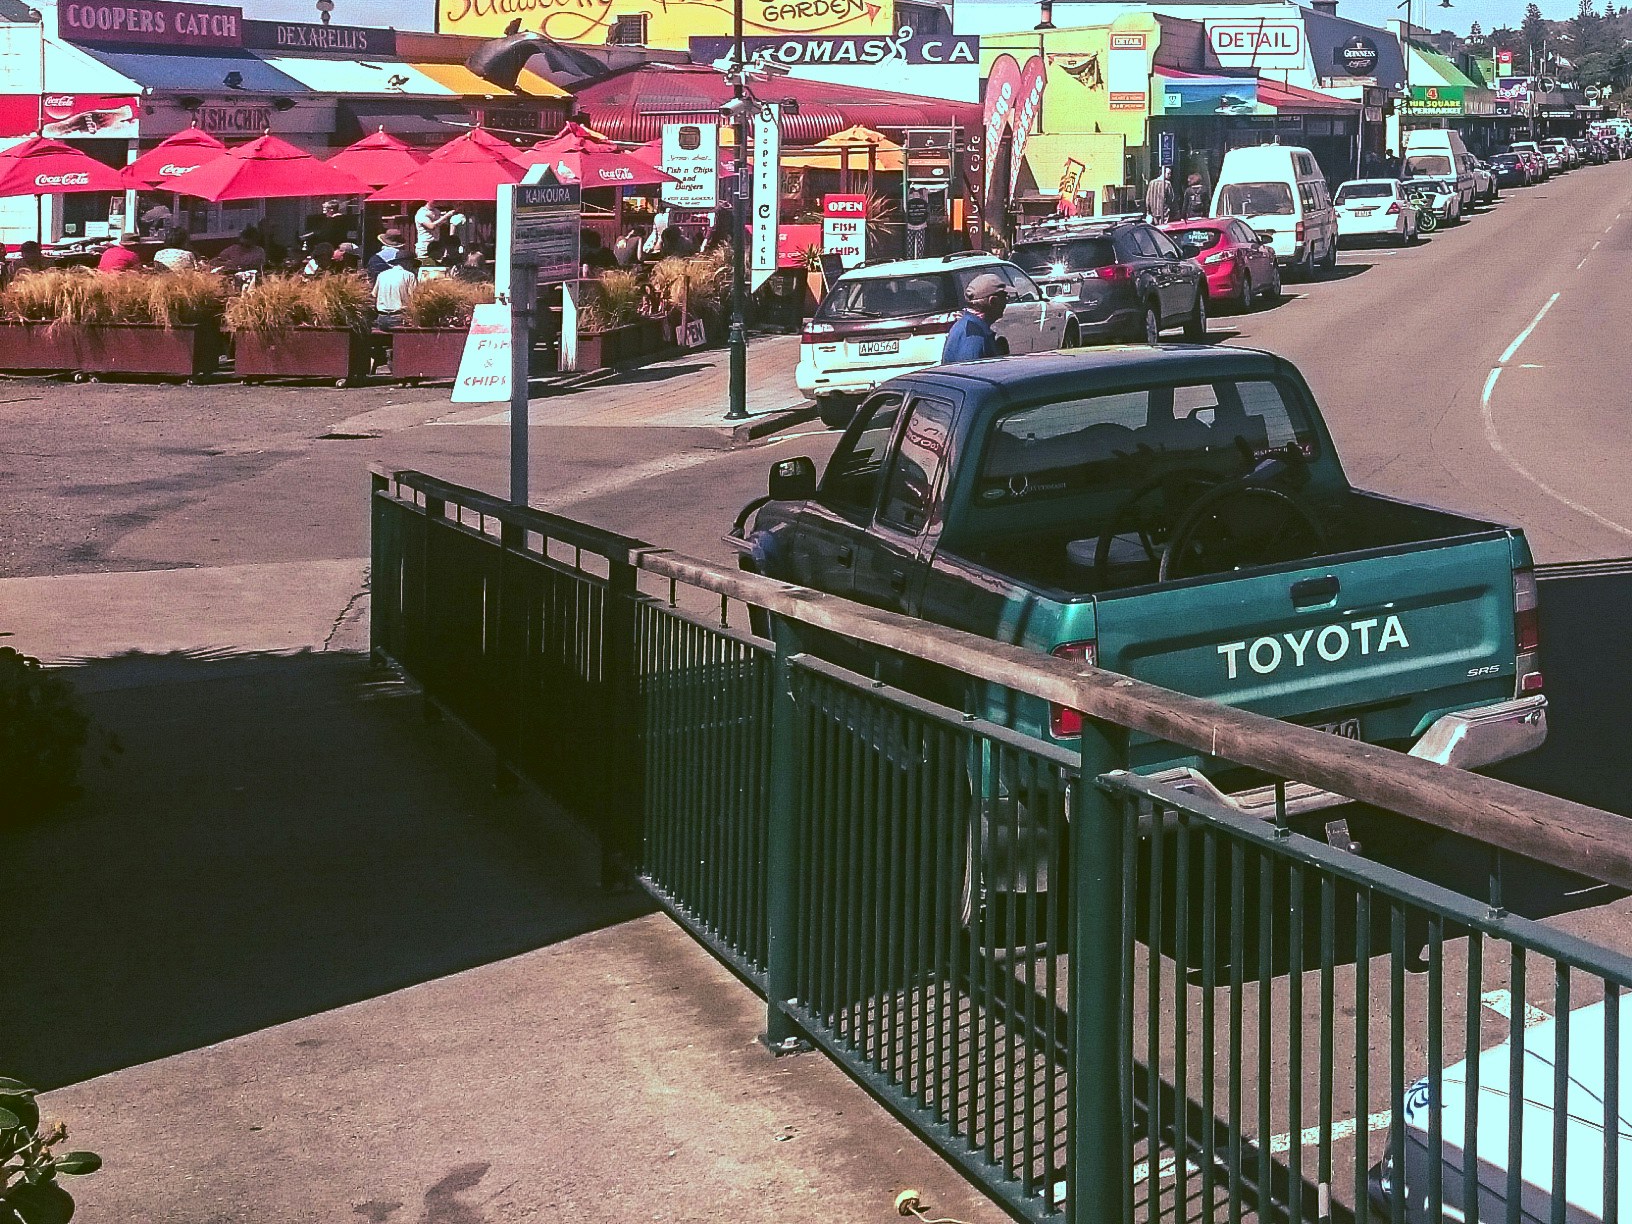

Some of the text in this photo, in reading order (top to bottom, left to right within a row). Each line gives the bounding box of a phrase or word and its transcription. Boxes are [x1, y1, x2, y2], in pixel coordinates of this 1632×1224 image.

[67, 3, 236, 37] COOPERS CATCH
[277, 25, 368, 50] DEXARELLI'S
[1114, 37, 1141, 46] DETAIL
[1217, 32, 1292, 48] DETAIL
[1426, 87, 1439, 100] 4
[525, 187, 571, 204] KAIKOURA
[828, 201, 863, 212] OPEN
[832, 222, 857, 232] FISH
[829, 247, 860, 256] CHIPS
[1217, 614, 1410, 679] TOYOTA
[1466, 663, 1501, 678] SR5
